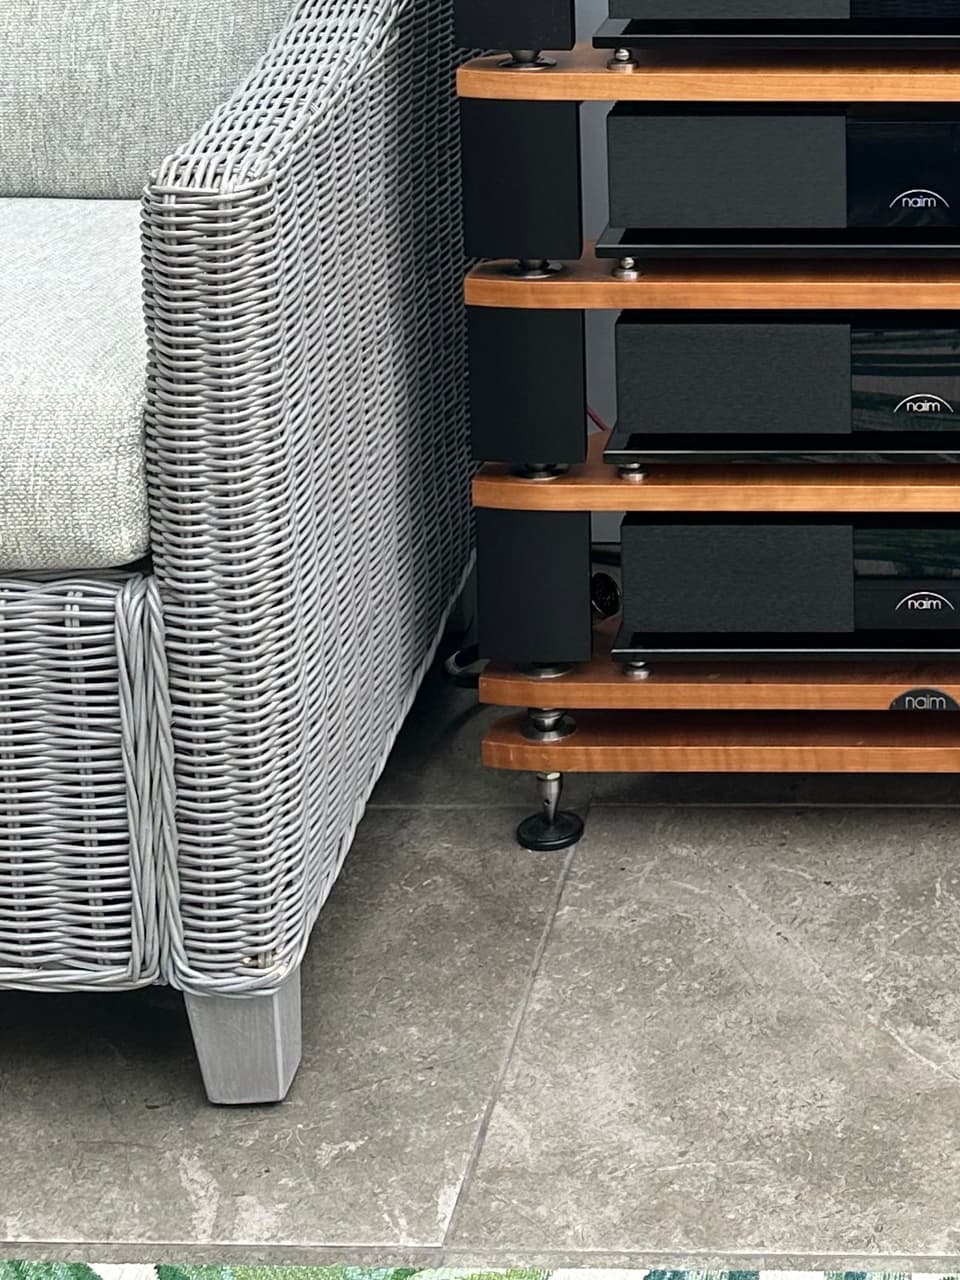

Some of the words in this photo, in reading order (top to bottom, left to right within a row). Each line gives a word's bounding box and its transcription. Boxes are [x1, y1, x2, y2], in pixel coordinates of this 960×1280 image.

[902, 195, 936, 207] naim
[906, 400, 940, 412] naim
[908, 598, 941, 609] naim
[905, 695, 946, 709] naim
